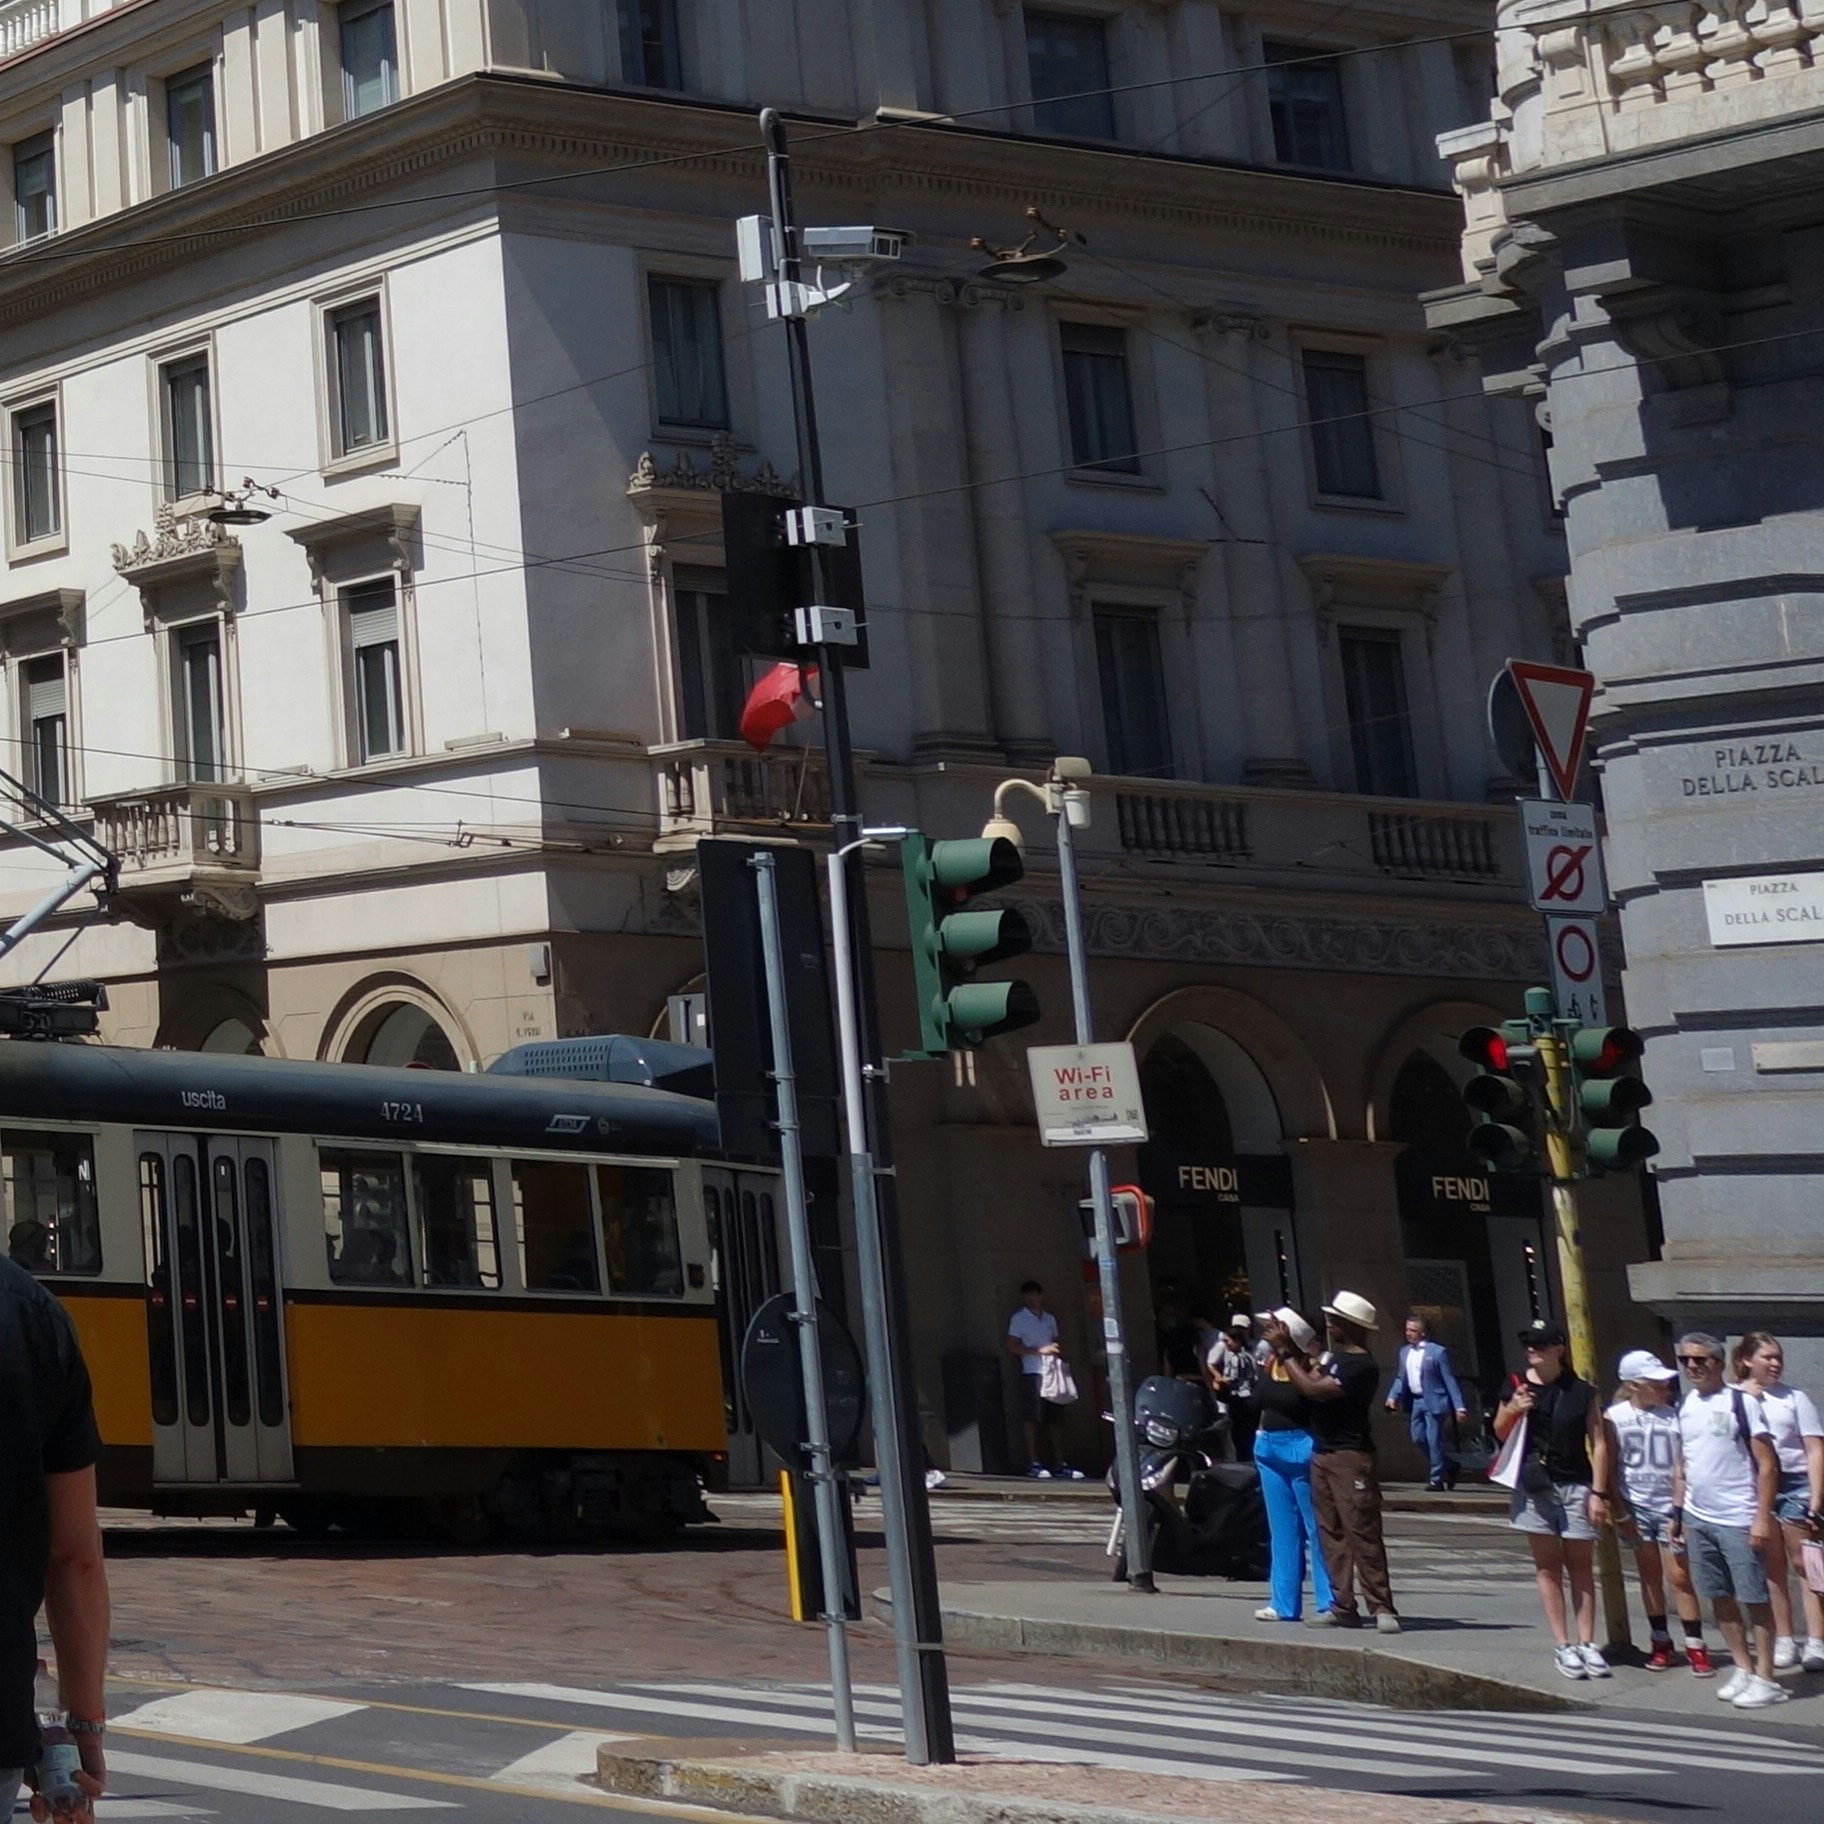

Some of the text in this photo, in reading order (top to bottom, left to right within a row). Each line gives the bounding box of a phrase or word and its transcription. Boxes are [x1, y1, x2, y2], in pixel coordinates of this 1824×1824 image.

[1714, 743, 1801, 768] PIAZZA
[1683, 766, 1824, 796] DELLA SCAL
[1750, 882, 1799, 895] PIAZZA
[1724, 906, 1824, 926] DELLA SCAL
[1054, 1066, 1111, 1084] Wi-Fi
[181, 1090, 227, 1110] uscita
[1059, 1086, 1114, 1101] area
[380, 1102, 424, 1123] 4724
[1178, 1166, 1238, 1191] FENDI
[1432, 1176, 1490, 1201] FENDI
